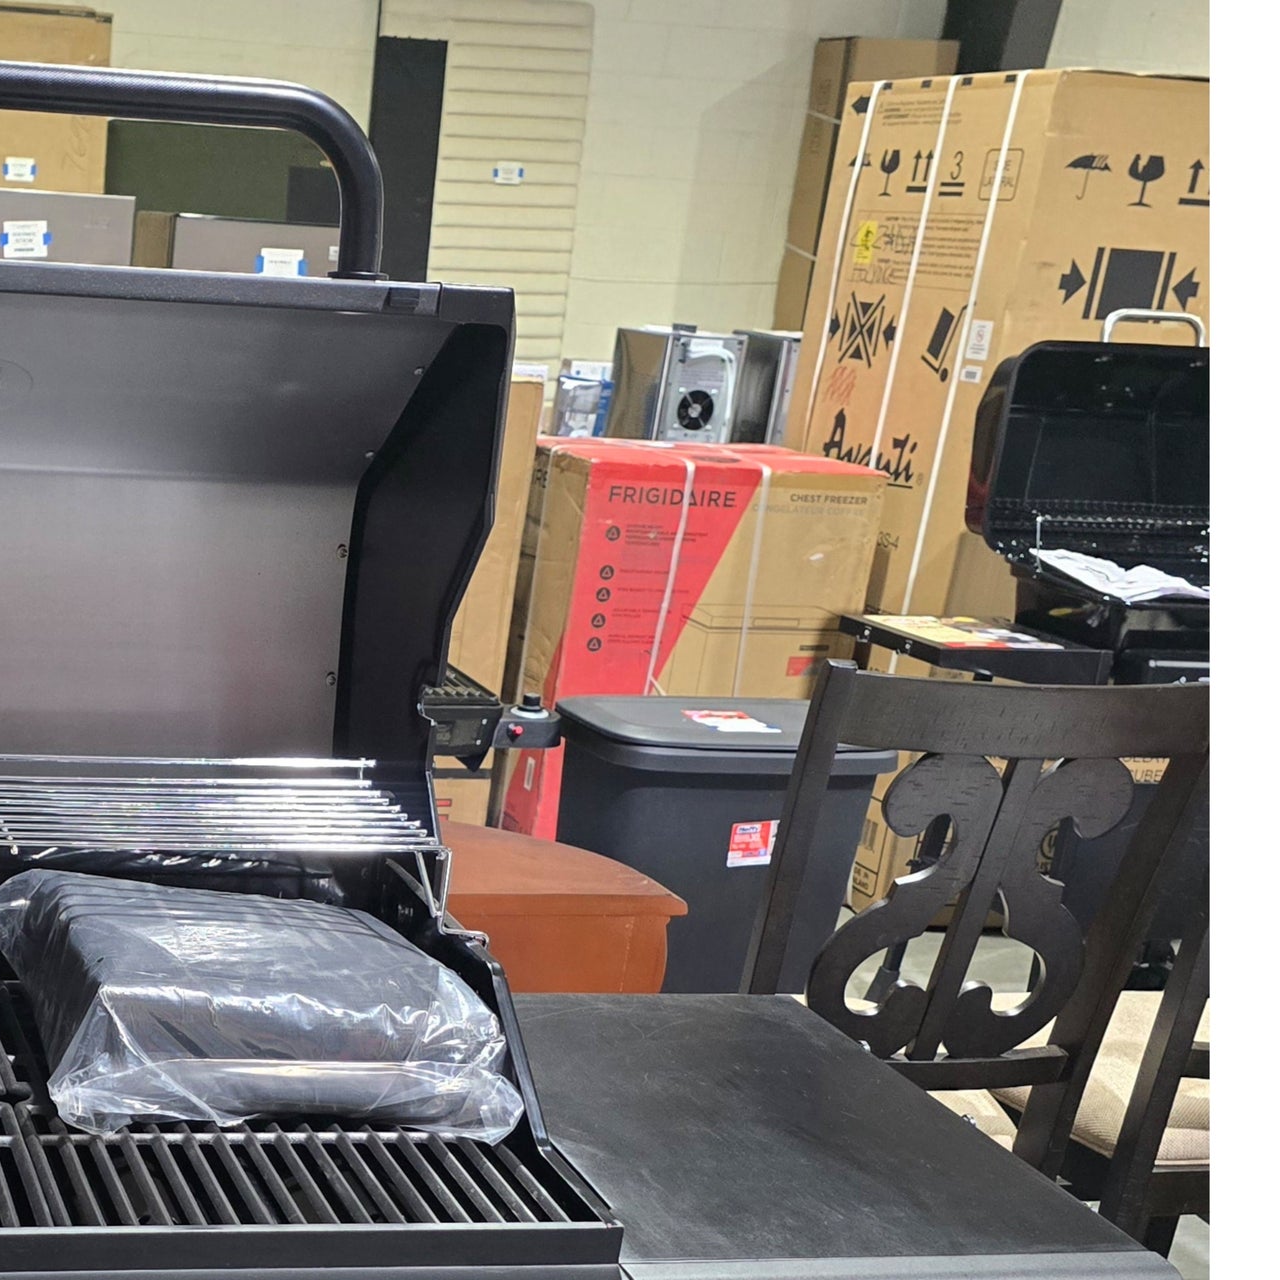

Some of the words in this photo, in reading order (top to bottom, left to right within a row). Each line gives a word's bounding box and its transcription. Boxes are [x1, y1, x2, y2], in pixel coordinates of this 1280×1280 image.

[609, 485, 736, 508] FRIGIDAIRE
[790, 493, 821, 504] CHEST
[823, 495, 868, 505] FREEZER
